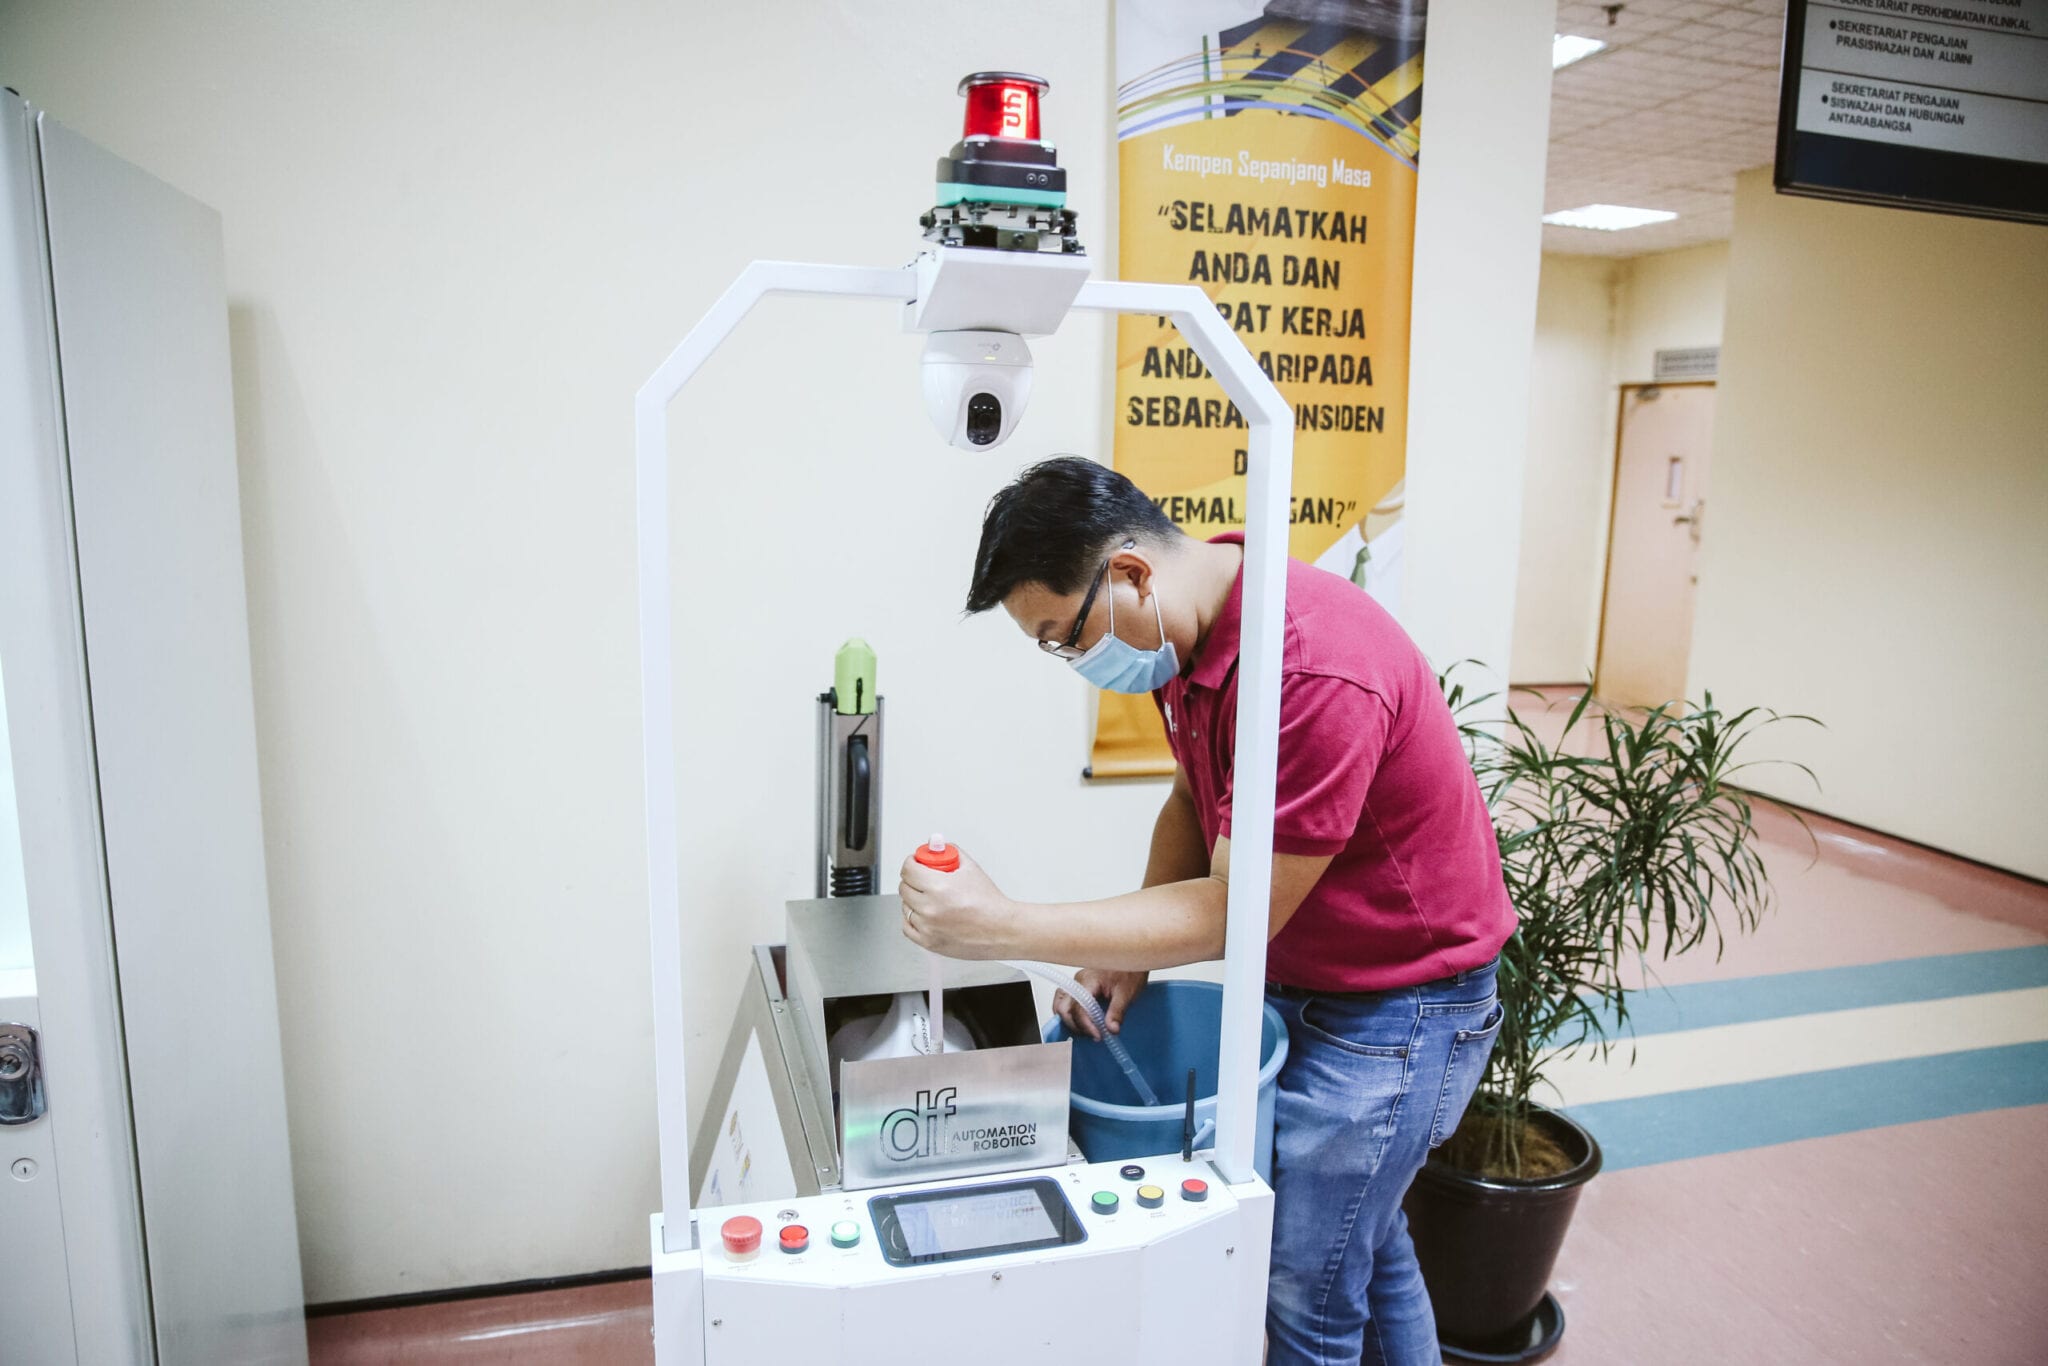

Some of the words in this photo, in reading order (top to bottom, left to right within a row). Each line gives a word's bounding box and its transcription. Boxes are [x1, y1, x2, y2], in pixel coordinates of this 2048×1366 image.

[1911, 3, 1986, 25] PERKHIDMATAN
[1987, 14, 2031, 31] KLINIKAL
[1836, 35, 1910, 56] PRASISWAZAH
[1913, 46, 1934, 60] DAN
[1938, 49, 1973, 65] ALUMNI
[1838, 20, 1908, 41] SEKRETARIAT
[1910, 31, 1968, 50] PENGAJIAN
[1831, 81, 1901, 101] SEKRETARIAT
[1903, 92, 1960, 109] PENGAJIAN
[1828, 112, 1912, 132] ANTARABANGSA
[1830, 97, 1883, 114] SISWAZAH
[1885, 105, 1907, 118] DAN
[1909, 108, 1966, 125] HUBUNGAN
[1163, 144, 1232, 178] Kempen
[1238, 151, 1327, 187] Sepanjang
[1333, 158, 1371, 187] Masa
[1189, 250, 1272, 286] ANDA
[1283, 255, 1340, 290] DAN
[1282, 306, 1366, 339] KERJA
[1141, 346, 1213, 380] AND
[1249, 350, 1373, 386] ARIPADA
[1127, 395, 1249, 429] SEBARA
[1296, 403, 1384, 433] INSIDEN
[953, 1122, 1037, 1142] AUTOMATION
[973, 1134, 1036, 1152] ROBOTICS
